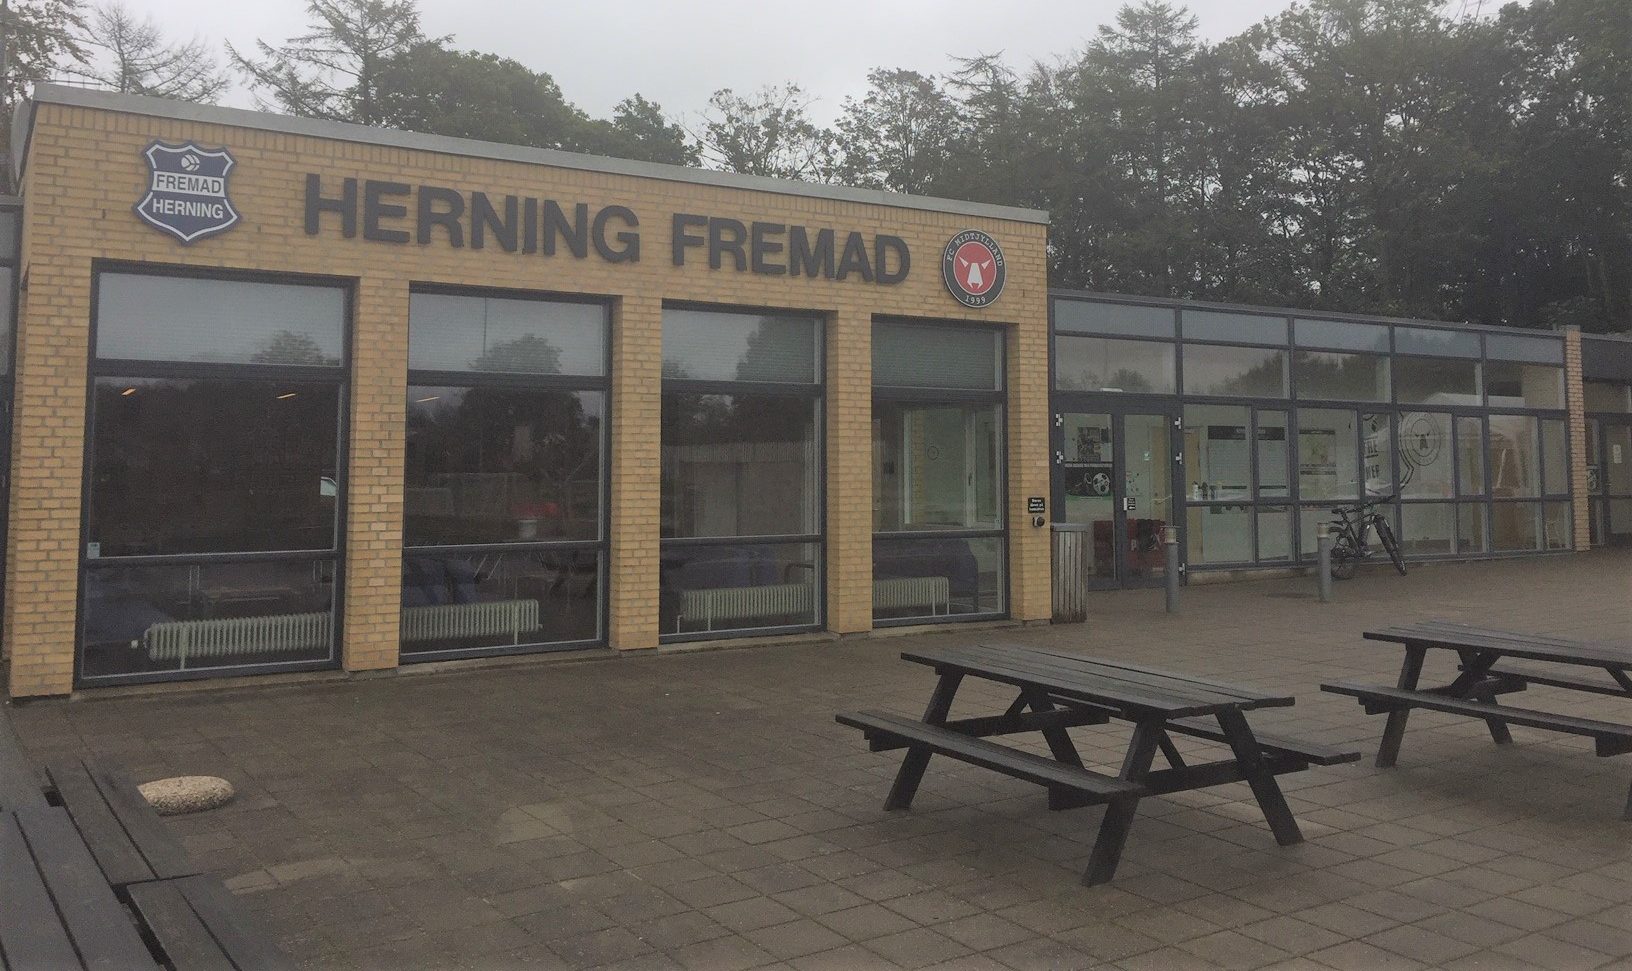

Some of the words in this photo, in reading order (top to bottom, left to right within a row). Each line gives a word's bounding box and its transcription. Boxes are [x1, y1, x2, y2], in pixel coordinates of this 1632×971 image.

[156, 174, 222, 194] FREMAD
[152, 198, 224, 219] HERNING
[304, 173, 640, 264] HERNING
[671, 212, 911, 285] FREMAD
[947, 249, 955, 261] FC
[955, 233, 1003, 266] MIDTJYLLAND
[965, 295, 986, 304] 1999
